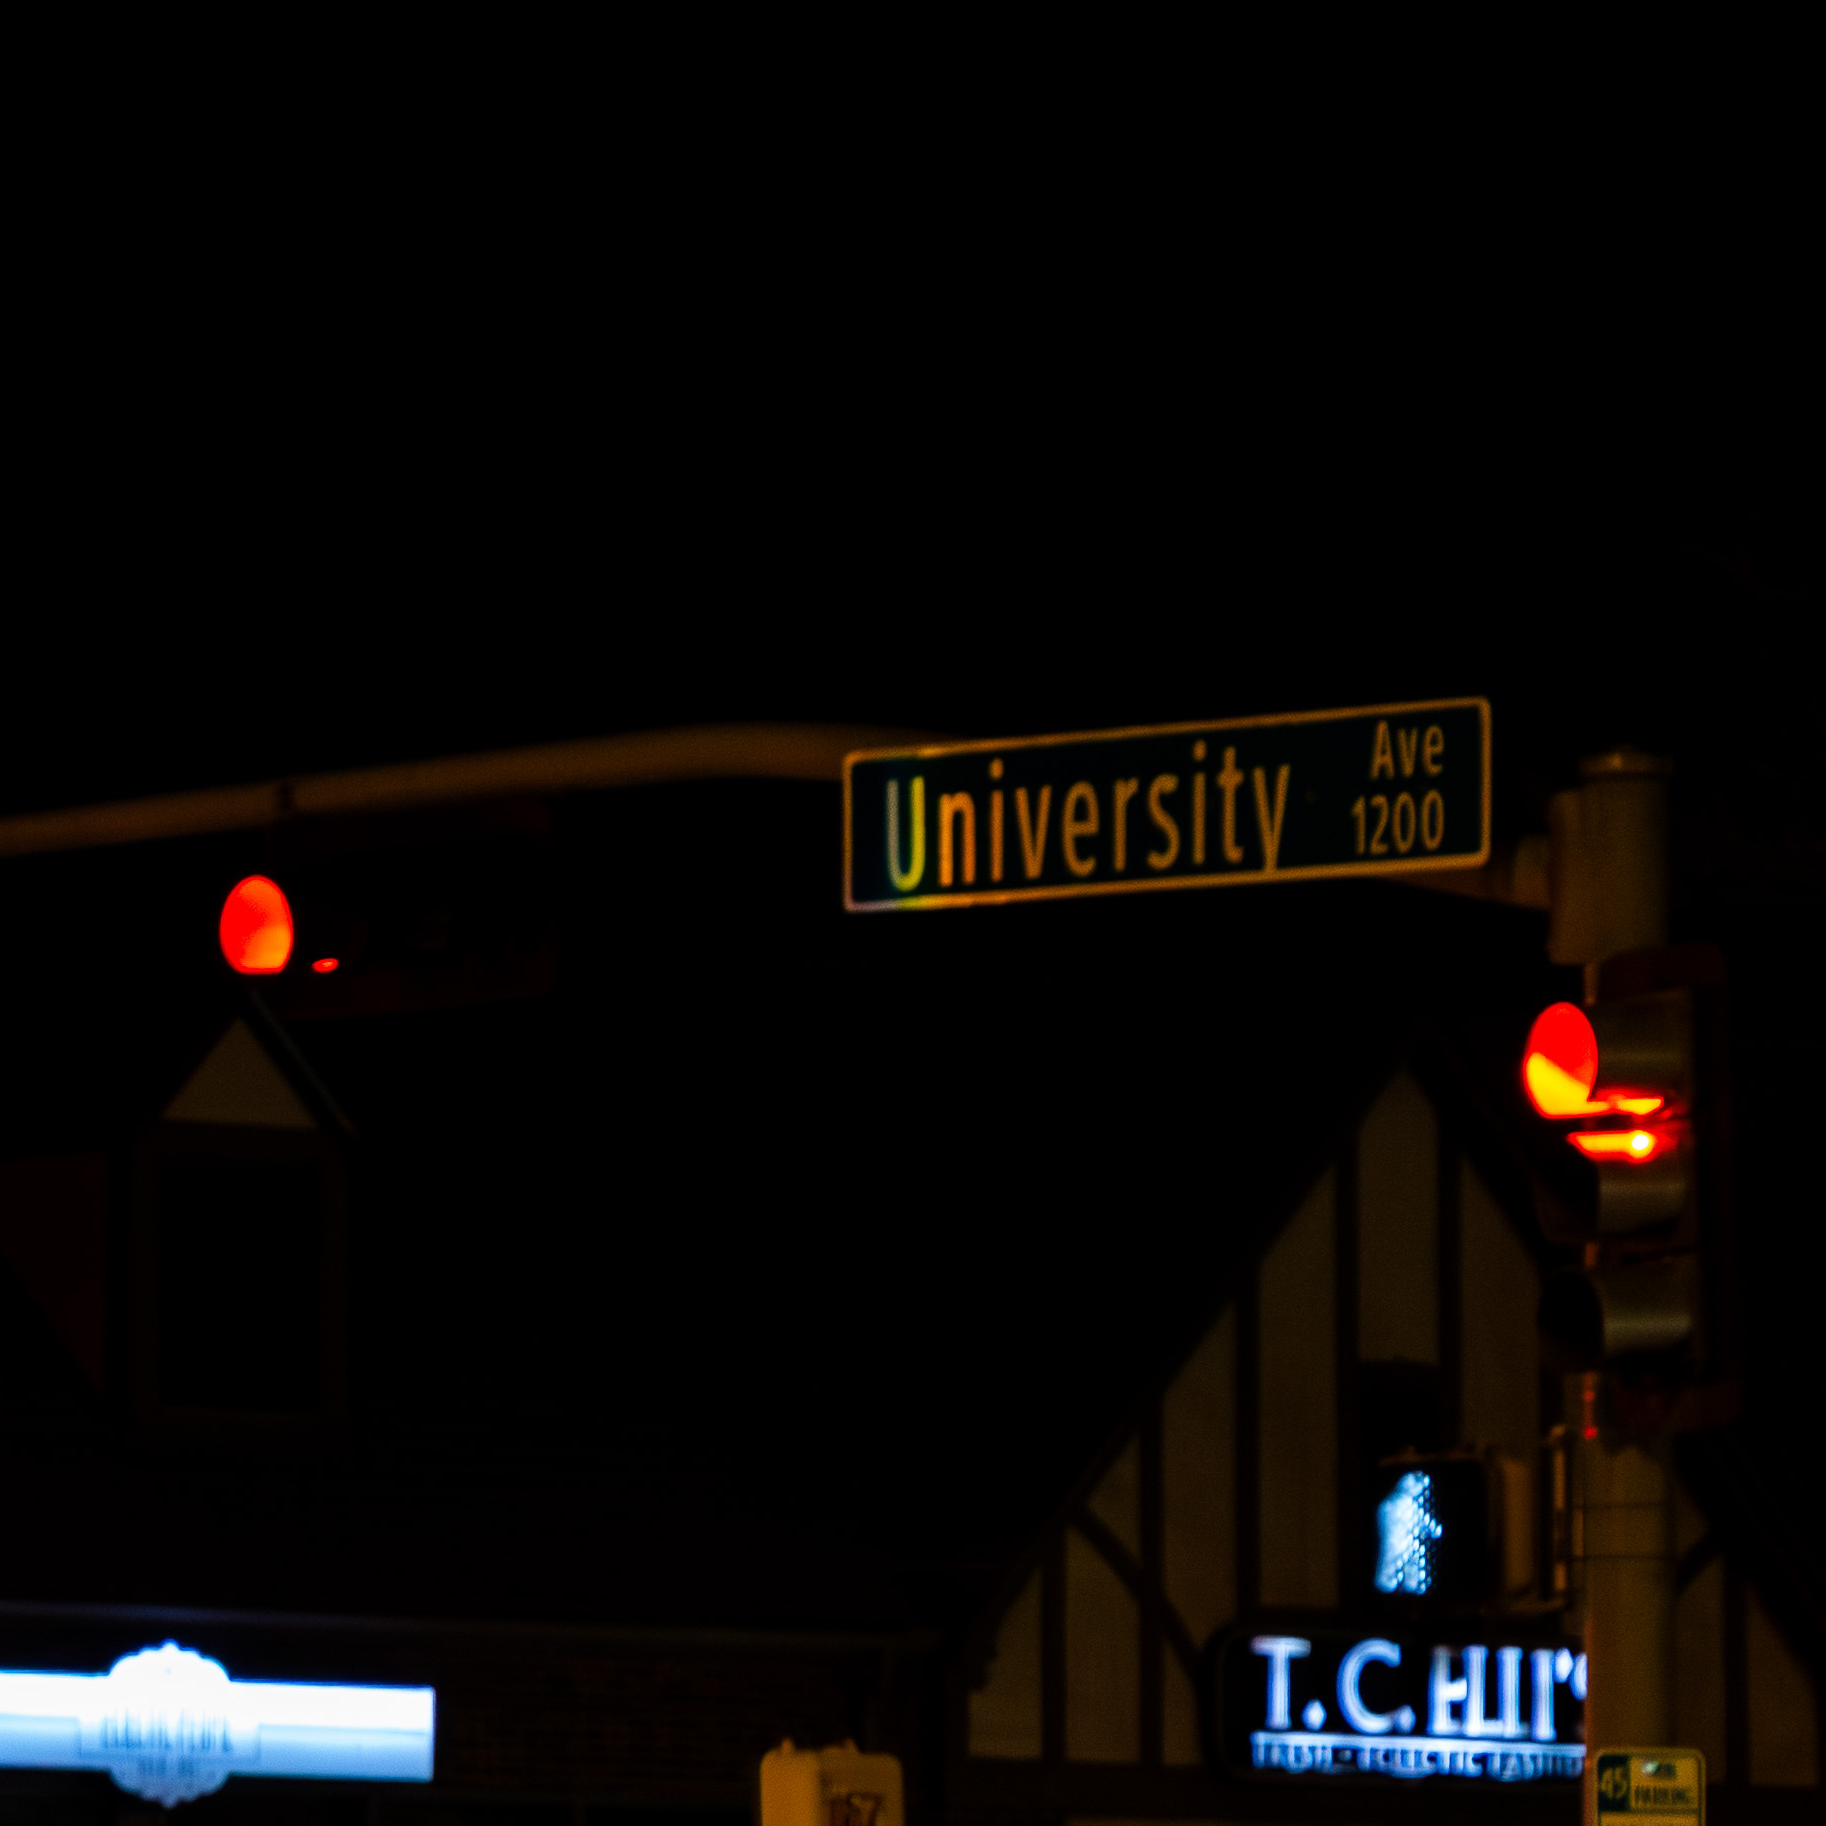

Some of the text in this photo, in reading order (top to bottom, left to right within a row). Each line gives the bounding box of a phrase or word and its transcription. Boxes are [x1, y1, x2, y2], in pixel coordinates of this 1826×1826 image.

[1370, 721, 1445, 780] Ave
[886, 739, 1291, 890] University
[1351, 789, 1445, 855] 1200
[1601, 1767, 1628, 1800] 45
